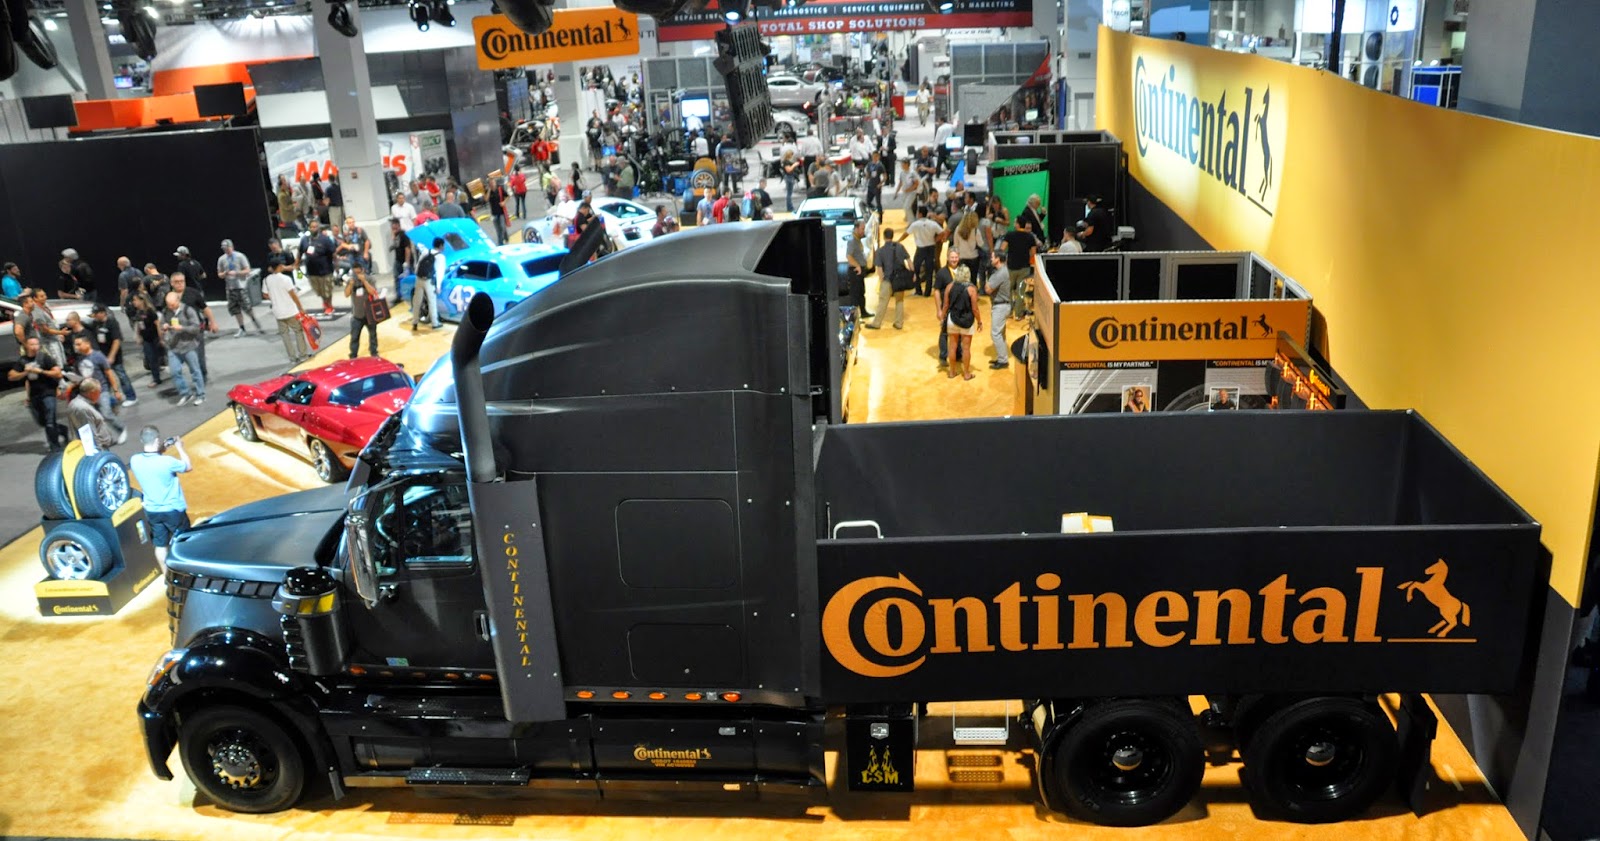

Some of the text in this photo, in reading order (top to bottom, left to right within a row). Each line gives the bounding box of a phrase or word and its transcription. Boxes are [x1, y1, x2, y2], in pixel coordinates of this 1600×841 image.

[774, 6, 828, 16] DIAGNOSTICS
[842, 3, 925, 13] SERVICE EQUIPMENT
[761, 17, 926, 33] TOTAL SHOP SOLUTIONS
[1135, 56, 1253, 196] Continental
[1089, 316, 1248, 349] Continental
[503, 533, 532, 666] CONTINENTAL
[821, 567, 1384, 677] Continental
[634, 747, 700, 760] Continental
